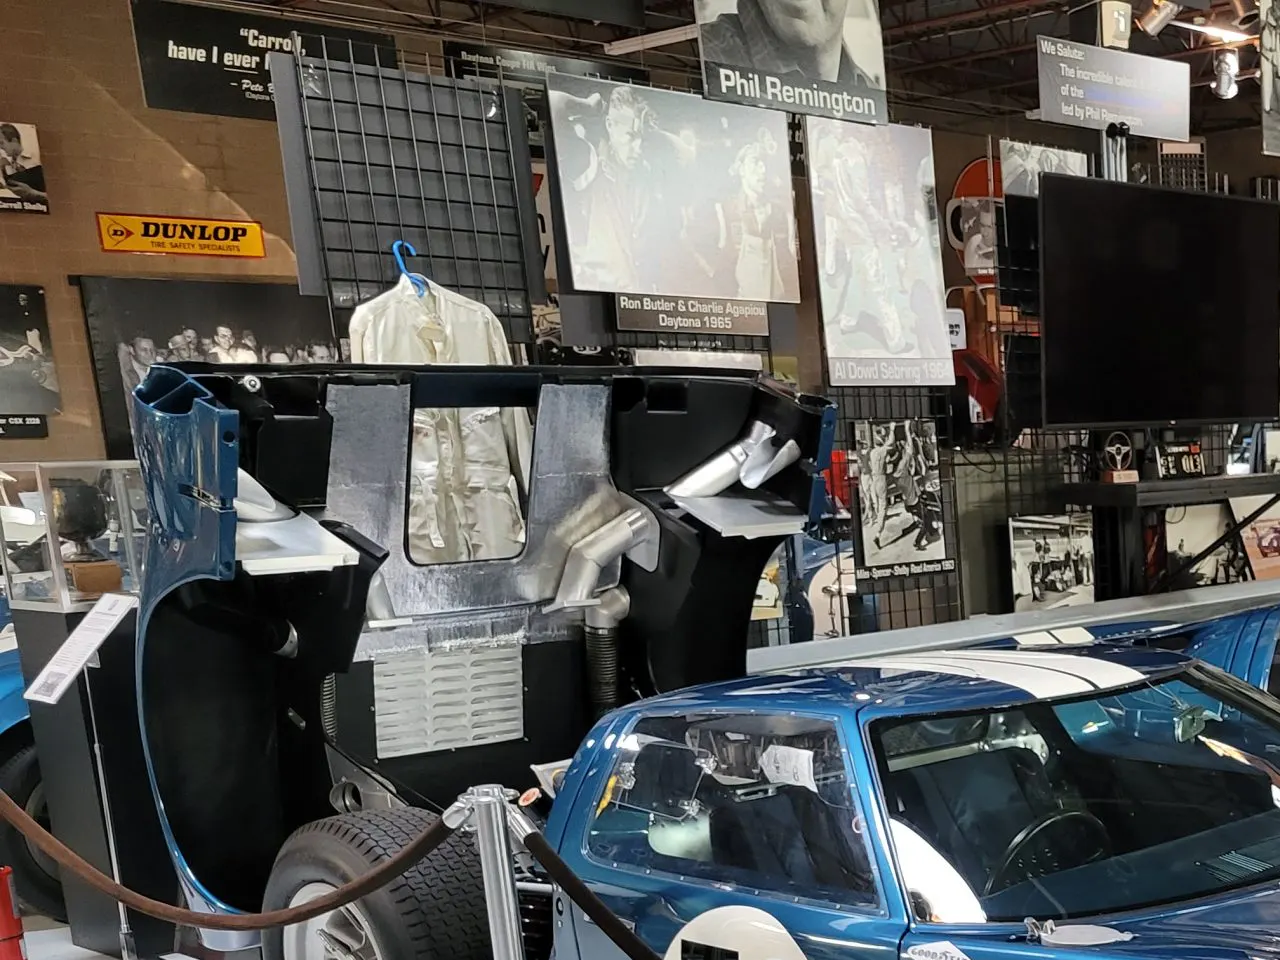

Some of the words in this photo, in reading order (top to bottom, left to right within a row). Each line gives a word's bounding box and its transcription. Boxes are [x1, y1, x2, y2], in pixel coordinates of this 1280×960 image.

[168, 40, 206, 62] have
[212, 46, 218, 64] I
[223, 52, 260, 70] ever
[1040, 40, 1056, 55] We
[1060, 63, 1075, 78] The
[241, 79, 264, 92] Pete
[719, 68, 761, 99] Phil
[765, 75, 877, 119] Remington
[1060, 84, 1070, 97] of
[1070, 86, 1084, 98] the
[1061, 102, 1074, 116] led
[1075, 104, 1085, 121] by
[1085, 106, 1100, 121] Phil
[141, 222, 248, 242] DUNLOP
[151, 241, 166, 249] TIRE
[170, 242, 195, 250] SAFETY
[620, 296, 641, 310] Ron
[643, 298, 676, 312] Butler
[677, 300, 687, 312] &
[688, 301, 723, 314] Charlie
[725, 302, 767, 318] Agapiou
[659, 314, 701, 330] Daytona
[703, 316, 732, 329] 1965
[848, 362, 879, 379] Dowd
[880, 362, 921, 383] Sebring
